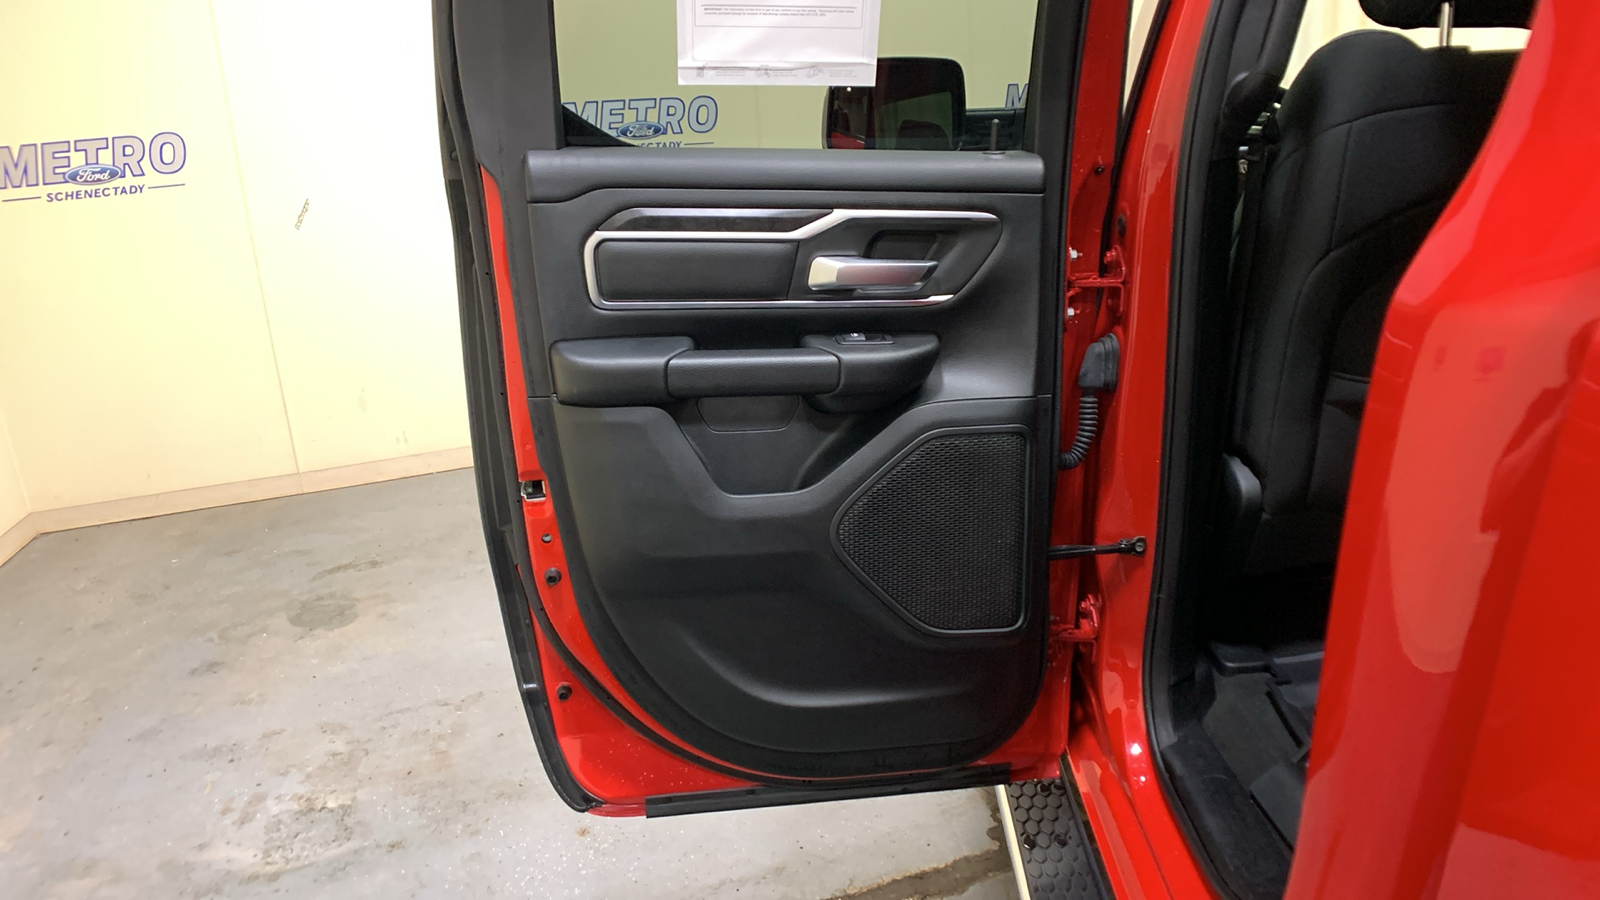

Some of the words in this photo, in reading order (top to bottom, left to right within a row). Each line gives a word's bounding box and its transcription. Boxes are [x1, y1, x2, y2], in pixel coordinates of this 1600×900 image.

[561, 95, 718, 137] METRO
[0, 131, 187, 190] METRO
[76, 167, 111, 182] Ford
[46, 184, 146, 203] SCHENECTADY
